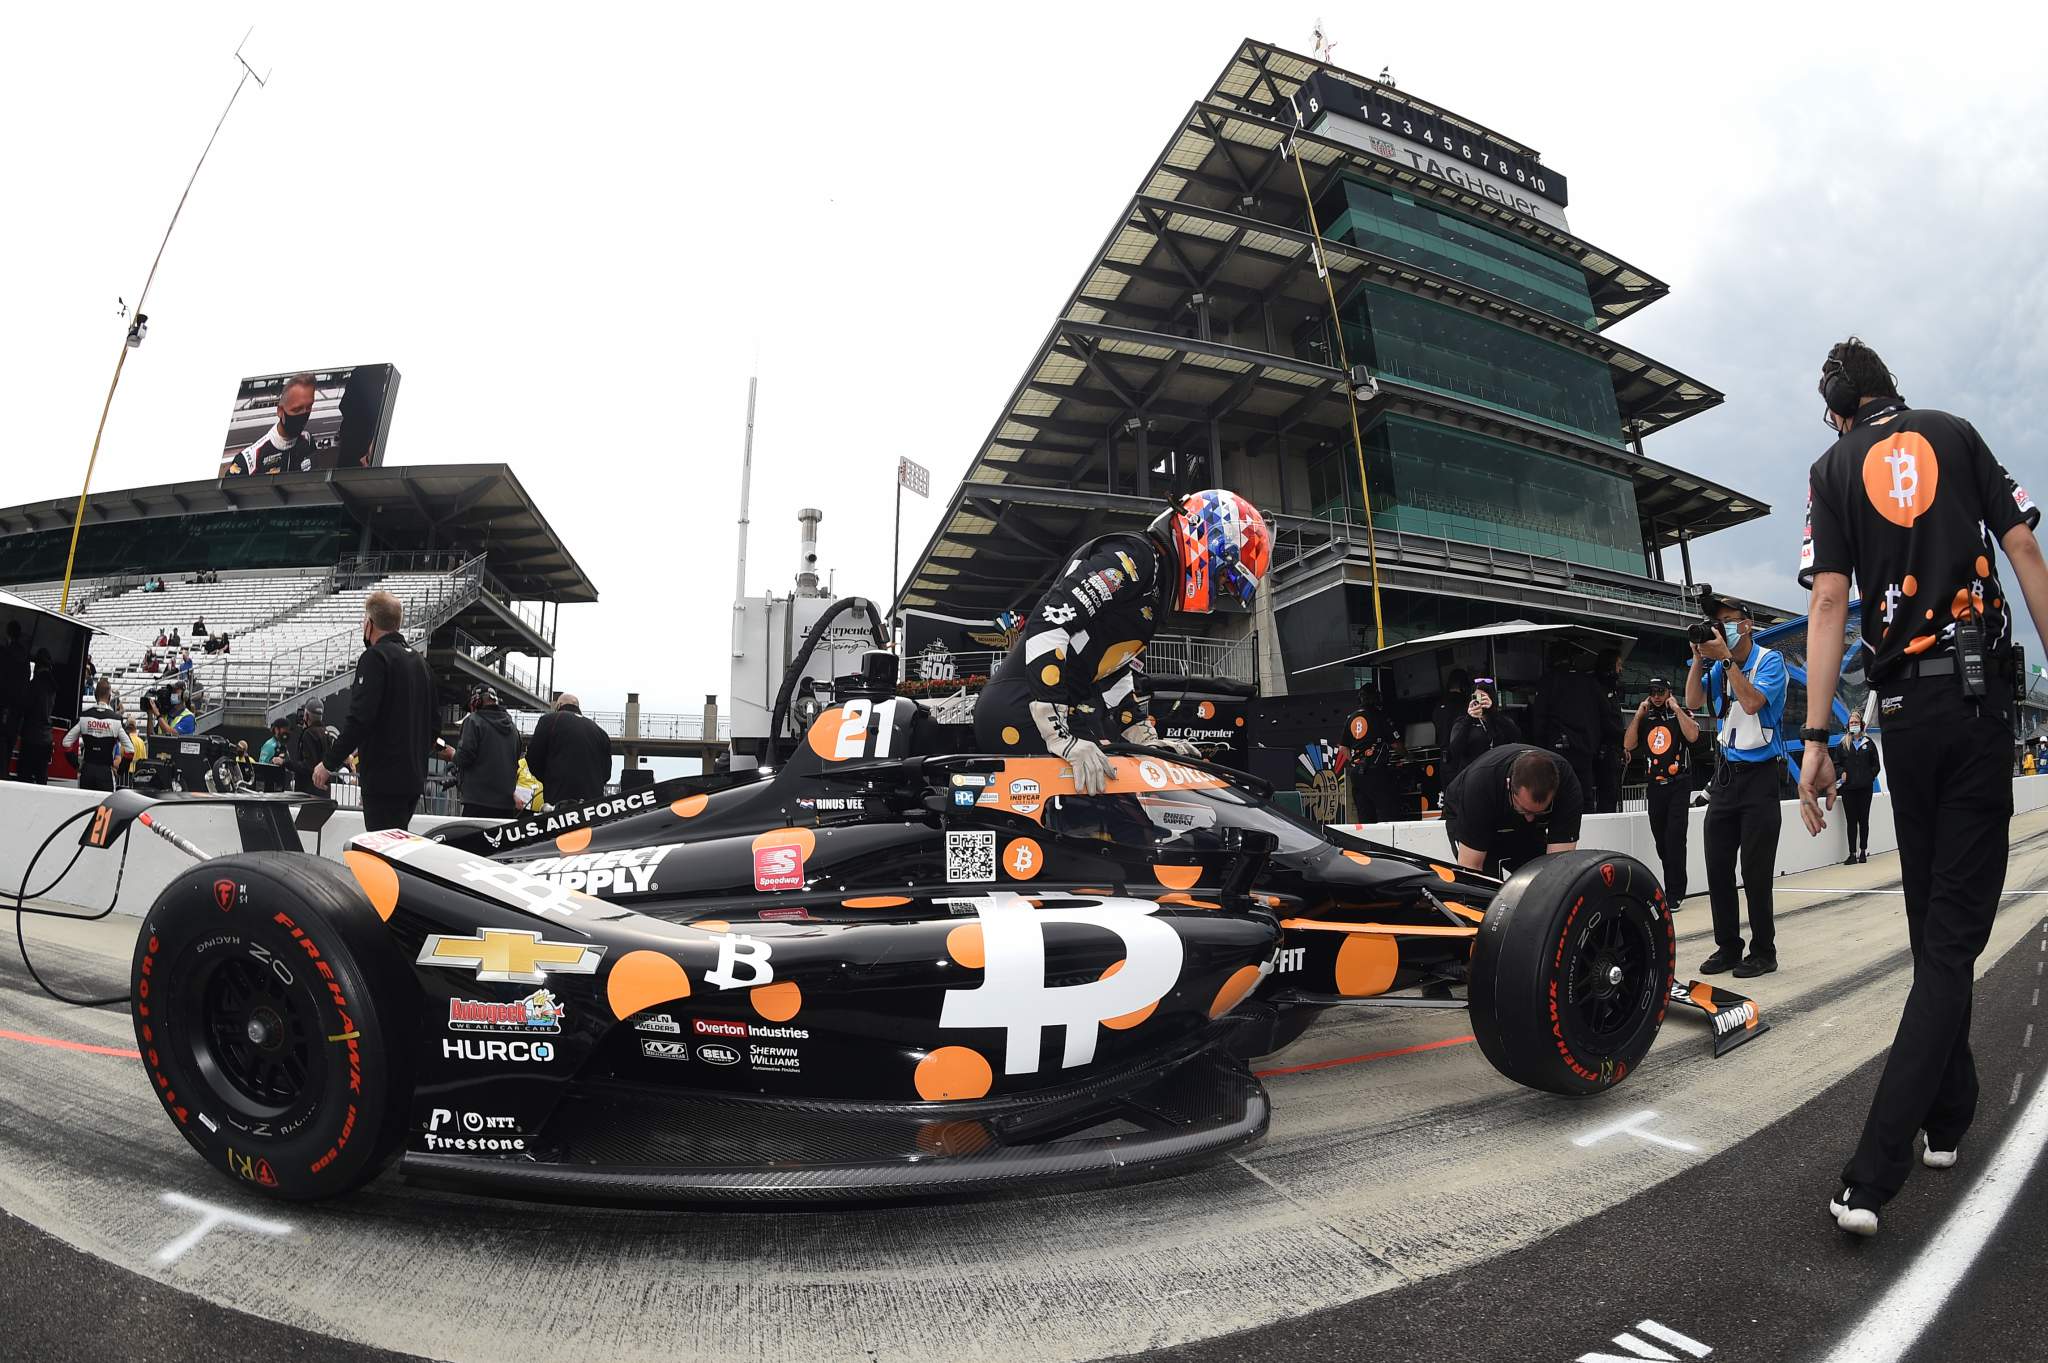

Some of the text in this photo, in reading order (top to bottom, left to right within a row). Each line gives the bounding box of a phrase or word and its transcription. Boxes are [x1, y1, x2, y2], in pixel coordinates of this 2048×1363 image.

[1309, 97, 1319, 113] 8
[1360, 105, 1546, 193] 1 2 3 4 5 6 7 8 9 10
[1081, 579, 1102, 608] HURCO
[920, 660, 954, 681] 500
[87, 720, 112, 730] SONAX
[834, 698, 897, 758] 21
[1166, 727, 1234, 740] Ed Carpenter
[816, 799, 865, 810] RINUS VEE
[90, 805, 113, 846] 21
[506, 790, 657, 843] U.S. AIR FORCE
[521, 843, 682, 876] DIRECT
[760, 876, 800, 886] Speedway
[273, 911, 360, 1095] FIREHAWK
[451, 999, 527, 1024] Autogeek
[476, 1023, 495, 1031] ARE
[640, 1023, 675, 1032] WELDERS
[1714, 1003, 1754, 1035] JUMBO
[695, 1021, 809, 1039] Overton Industries
[1549, 978, 1599, 1082] FIREHAWK
[442, 1038, 555, 1062] HURCO
[702, 1048, 735, 1061] BELL
[750, 1044, 798, 1057] SHERWIN
[750, 1054, 800, 1067] WILLIAMS
[485, 1116, 515, 1129] NTT
[424, 1132, 525, 1150] Firestone
